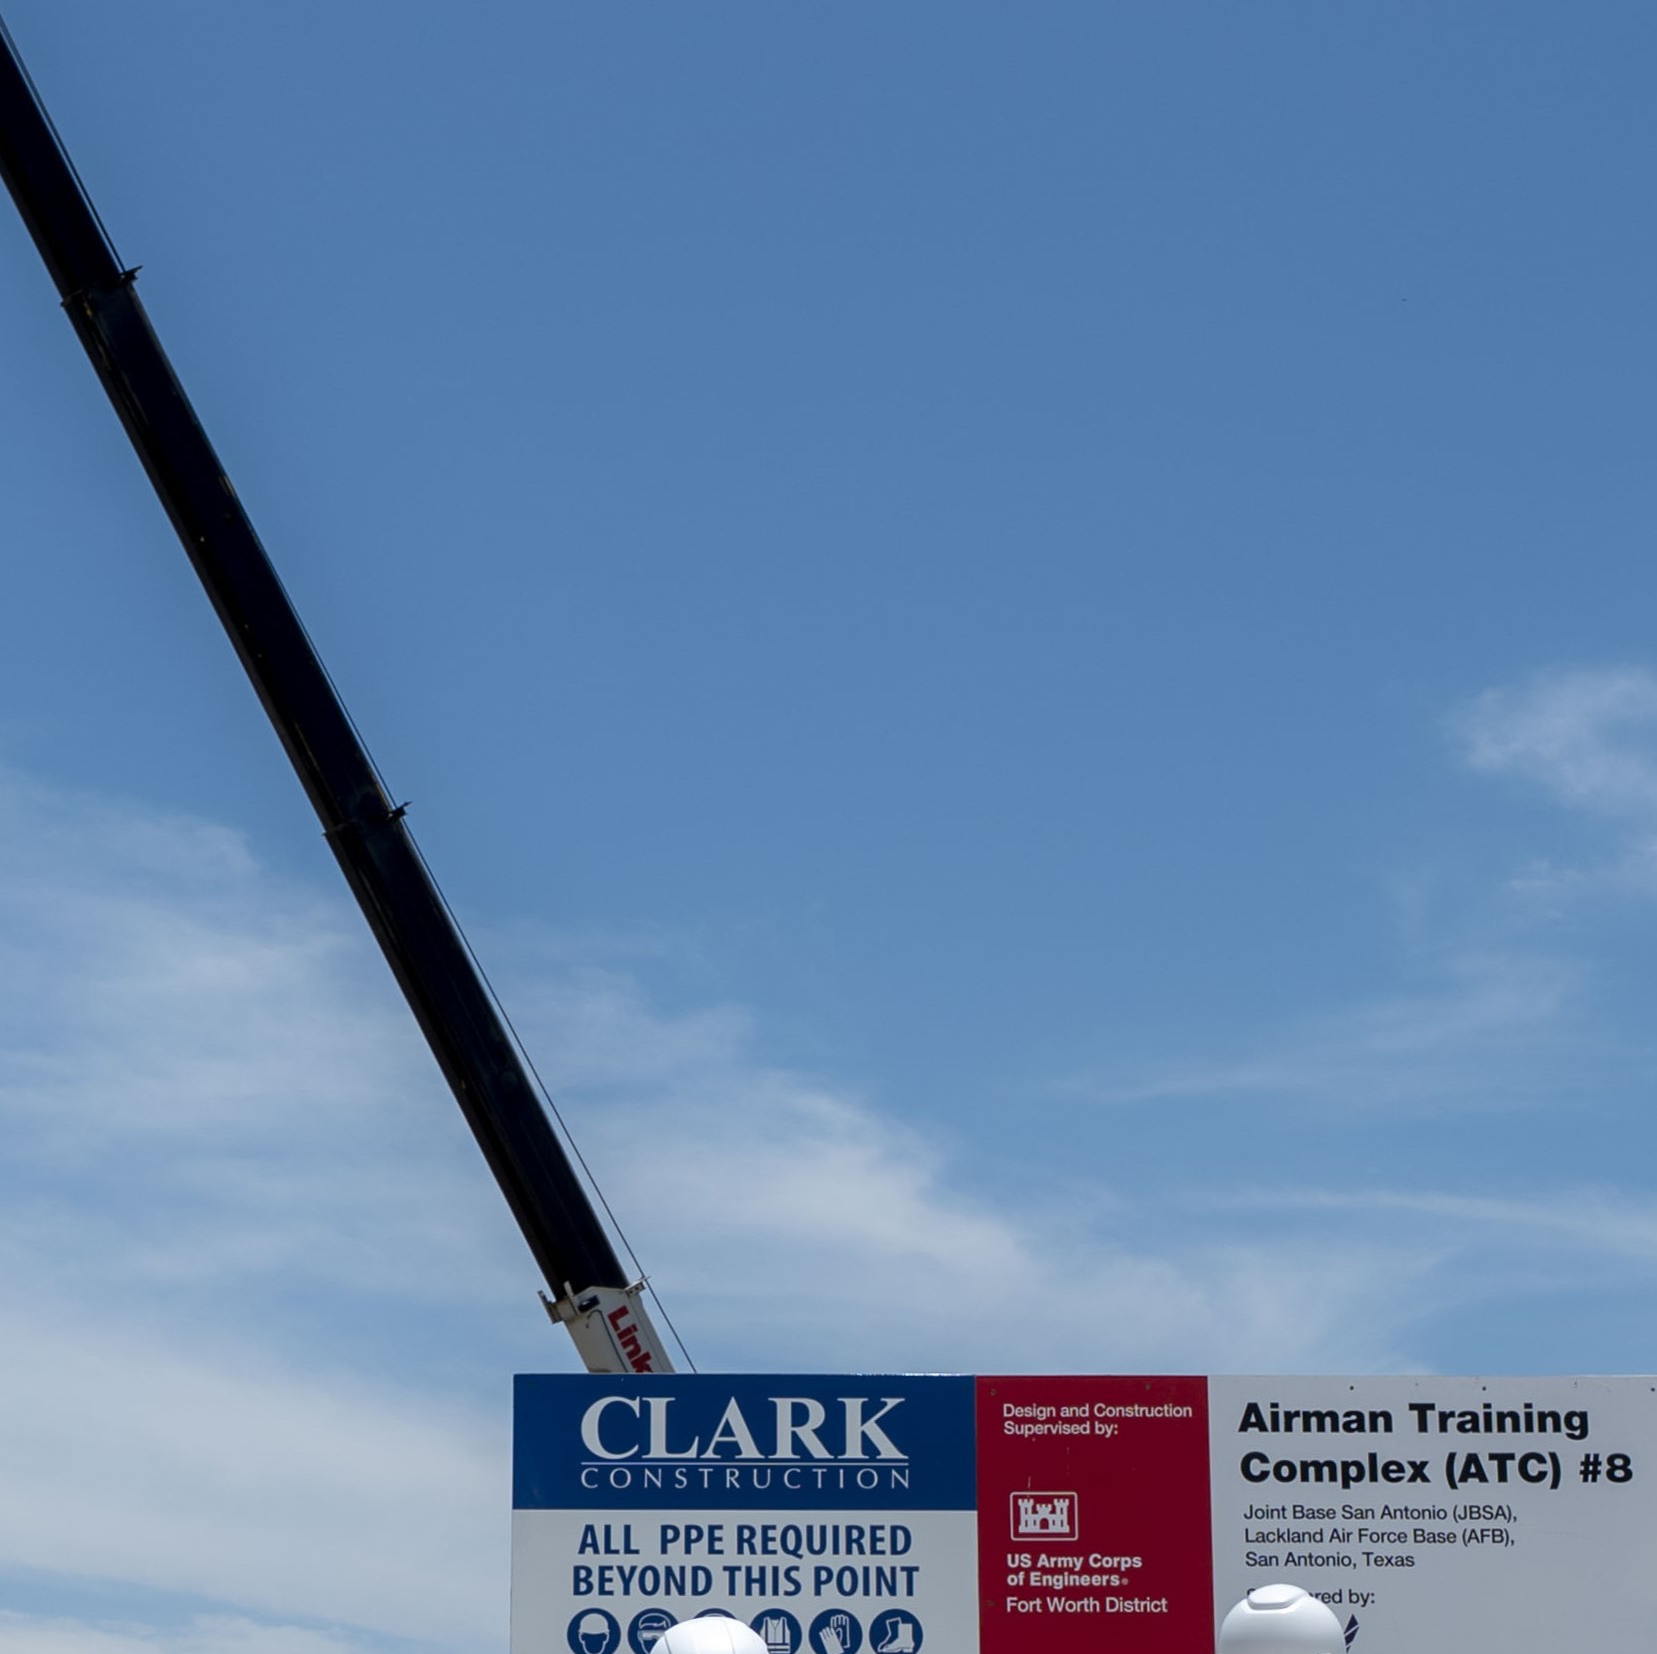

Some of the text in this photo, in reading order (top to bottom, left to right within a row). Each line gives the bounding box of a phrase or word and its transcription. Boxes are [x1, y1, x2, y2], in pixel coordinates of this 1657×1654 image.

[1004, 1403, 1192, 1420] Design and Construction
[581, 1395, 909, 1460] CLARK
[1004, 1421, 1118, 1438] Supervised by:
[1239, 1403, 1588, 1440] Airman Training
[581, 1468, 908, 1489] CONSTRUCTION
[1241, 1452, 1632, 1489] Complex (ATC) #8
[1244, 1505, 1516, 1523] Joint Base San Antonio (JBSA),
[578, 1525, 911, 1559] ALL PPE REQUIRED
[1245, 1528, 1514, 1547] Lackland Air Force Base (AFB),
[1007, 1554, 1142, 1571] US Army Corps
[1246, 1552, 1415, 1569] San Antonio, Texas
[573, 1566, 919, 1596] BEYOND THIS POINT
[1007, 1572, 1024, 1585] of
[1007, 1597, 1167, 1612] Fort Worth District
[1349, 1589, 1374, 1607] by:
